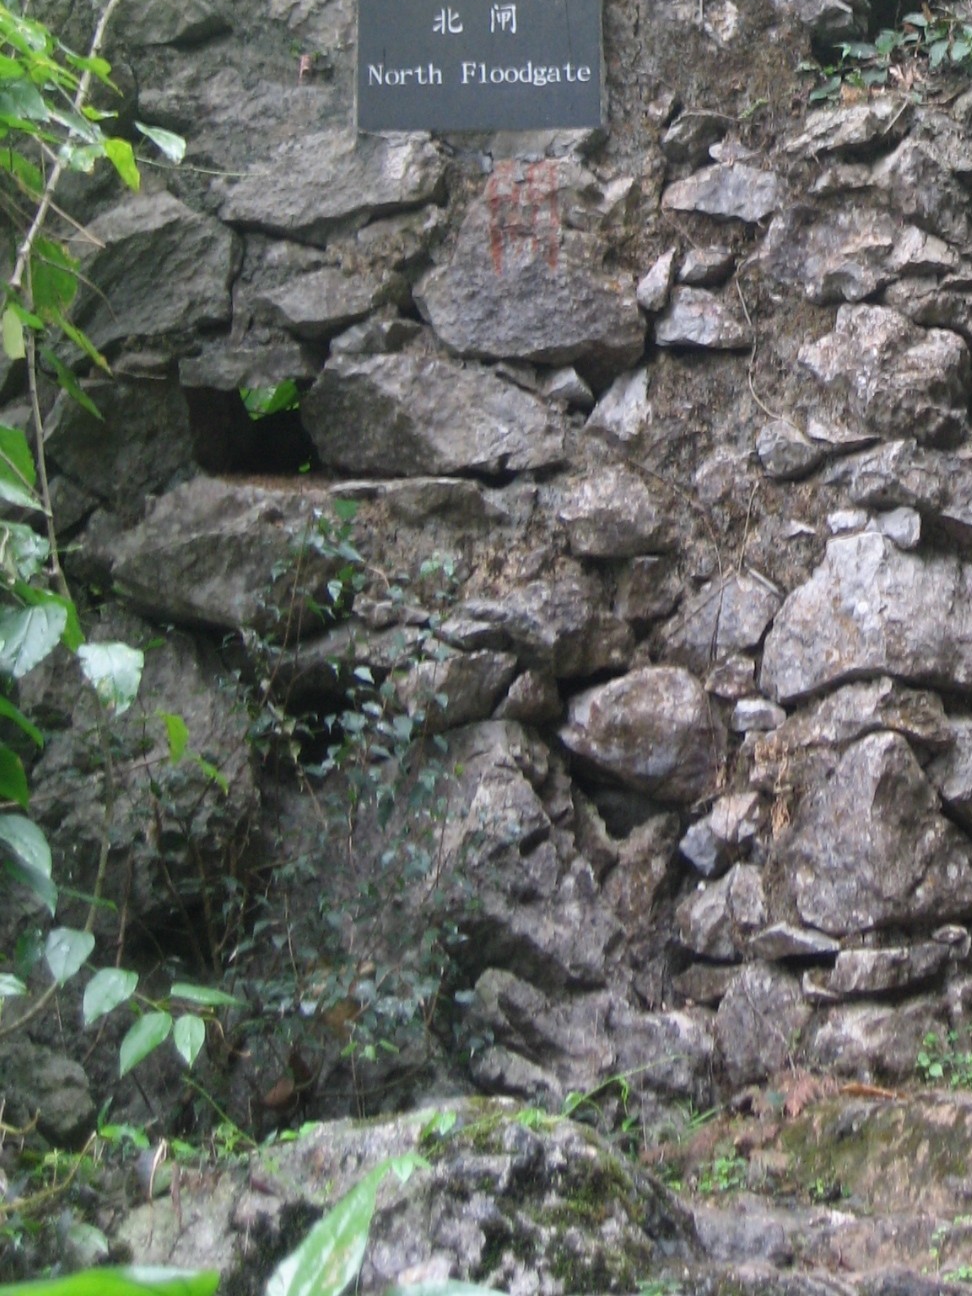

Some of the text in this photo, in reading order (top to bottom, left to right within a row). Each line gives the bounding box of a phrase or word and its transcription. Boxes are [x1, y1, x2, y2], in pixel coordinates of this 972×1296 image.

[433, 4, 517, 35] 北闸
[368, 61, 591, 86] North Floodgate
